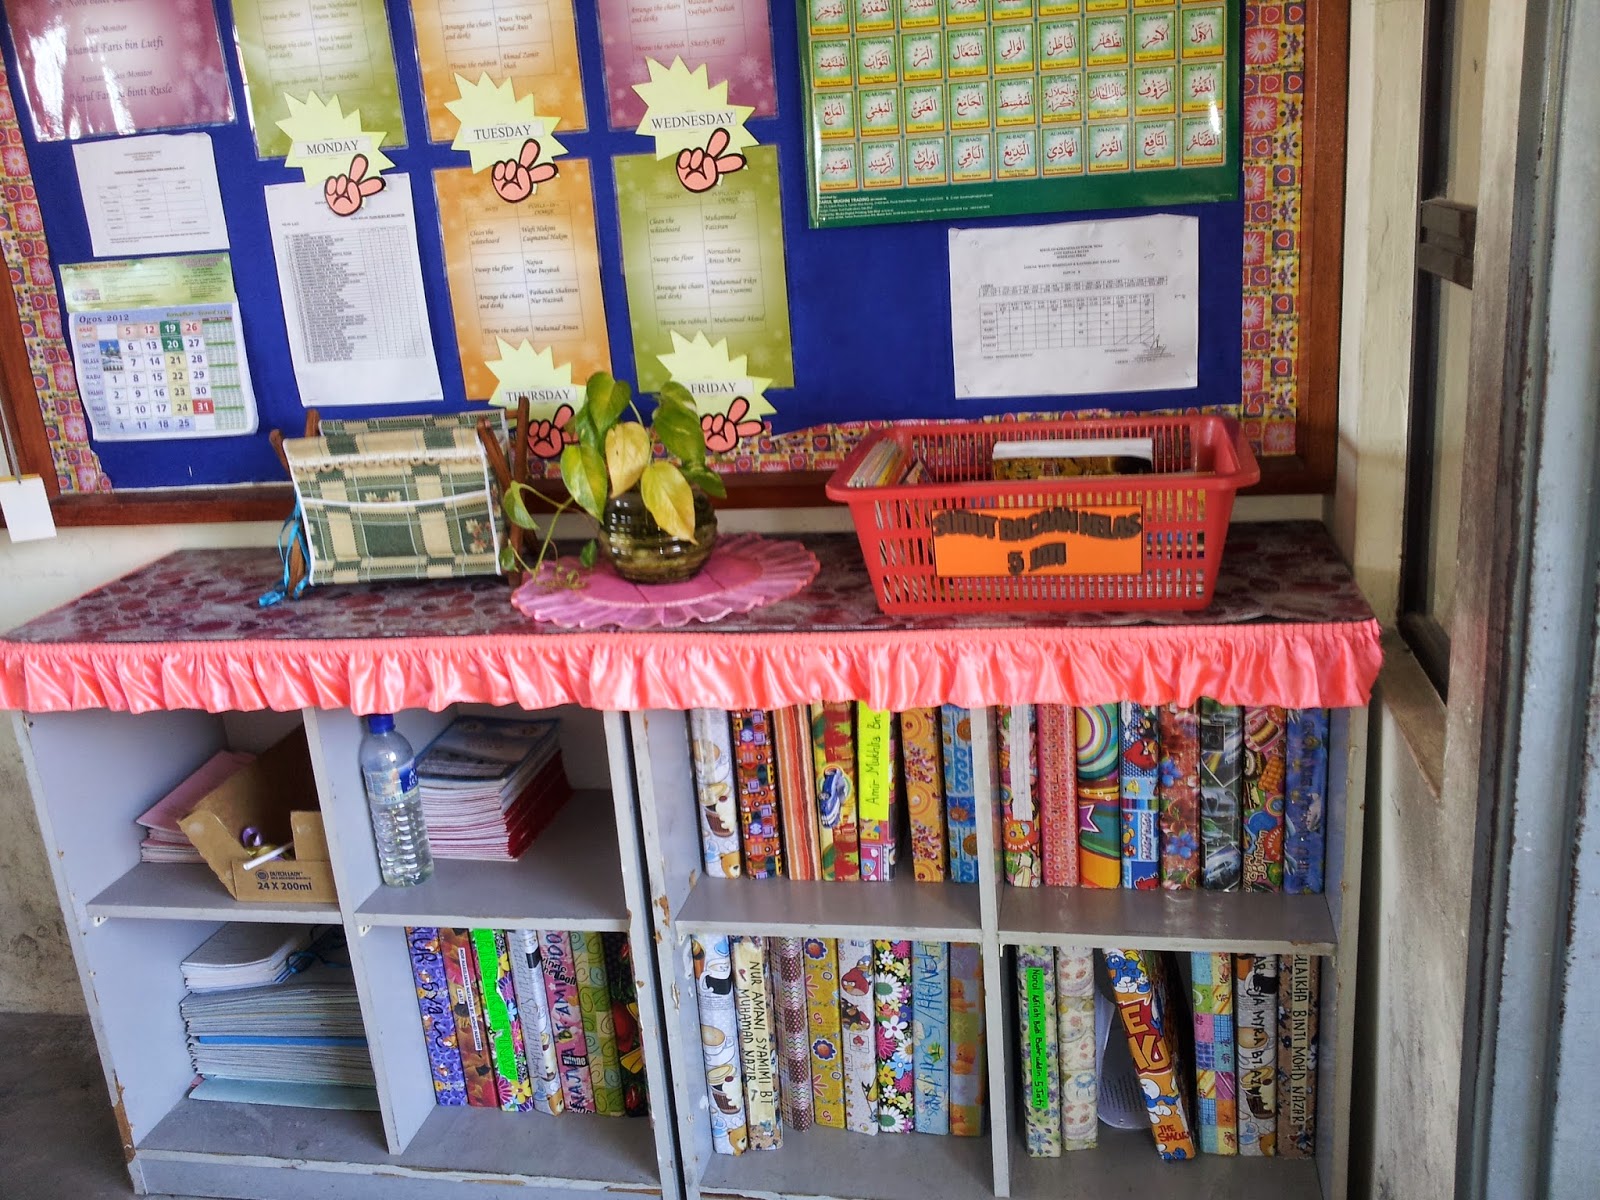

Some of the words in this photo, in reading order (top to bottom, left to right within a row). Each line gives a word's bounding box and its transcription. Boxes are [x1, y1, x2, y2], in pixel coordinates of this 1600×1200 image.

[125, 40, 138, 49] bin
[128, 87, 147, 97] binti
[651, 112, 735, 130] WEDNESDAY
[473, 125, 532, 140] TUESDAY
[306, 140, 359, 155] MONDAY
[79, 315, 103, 325] Ogos
[107, 314, 129, 322] 2012
[125, 327, 131, 335] 5
[144, 326, 155, 334] 12
[165, 325, 176, 333] 19
[186, 323, 198, 331] 26
[128, 343, 134, 351] 6
[146, 341, 157, 350] 13
[166, 340, 179, 348] 20
[189, 339, 199, 347] 27
[130, 358, 136, 367] 7
[150, 357, 160, 365] 14
[170, 356, 181, 364] 21
[191, 355, 203, 363] 28
[113, 375, 118, 383] 1
[133, 374, 139, 382] 8
[152, 373, 162, 381] 15
[172, 372, 183, 380] 22
[193, 371, 204, 379] 29
[114, 391, 119, 399] 2
[135, 389, 141, 398] 9
[154, 389, 164, 397] 16
[174, 388, 185, 396] 23
[690, 382, 738, 394] FRIDAY
[506, 389, 571, 402] THURSDAY
[116, 407, 121, 415] 3
[156, 405, 167, 413] 17
[177, 404, 188, 412] 24
[197, 403, 209, 411] 31
[119, 422, 125, 430] 4
[137, 421, 147, 429] 11
[158, 420, 169, 428] 18
[179, 419, 190, 427] 25
[257, 882, 270, 890] 24
[273, 882, 279, 890] X
[281, 882, 312, 890] 200ml
[749, 961, 763, 986] NUR
[738, 987, 754, 1045] MUHAMAD
[752, 991, 766, 1031] AMANI
[1293, 1010, 1307, 1042] BINTI
[744, 1050, 757, 1083] NAZIR
[756, 1037, 772, 1084] SYAMIMI
[1292, 1046, 1305, 1081] MOHD
[1158, 1124, 1176, 1133] THE
